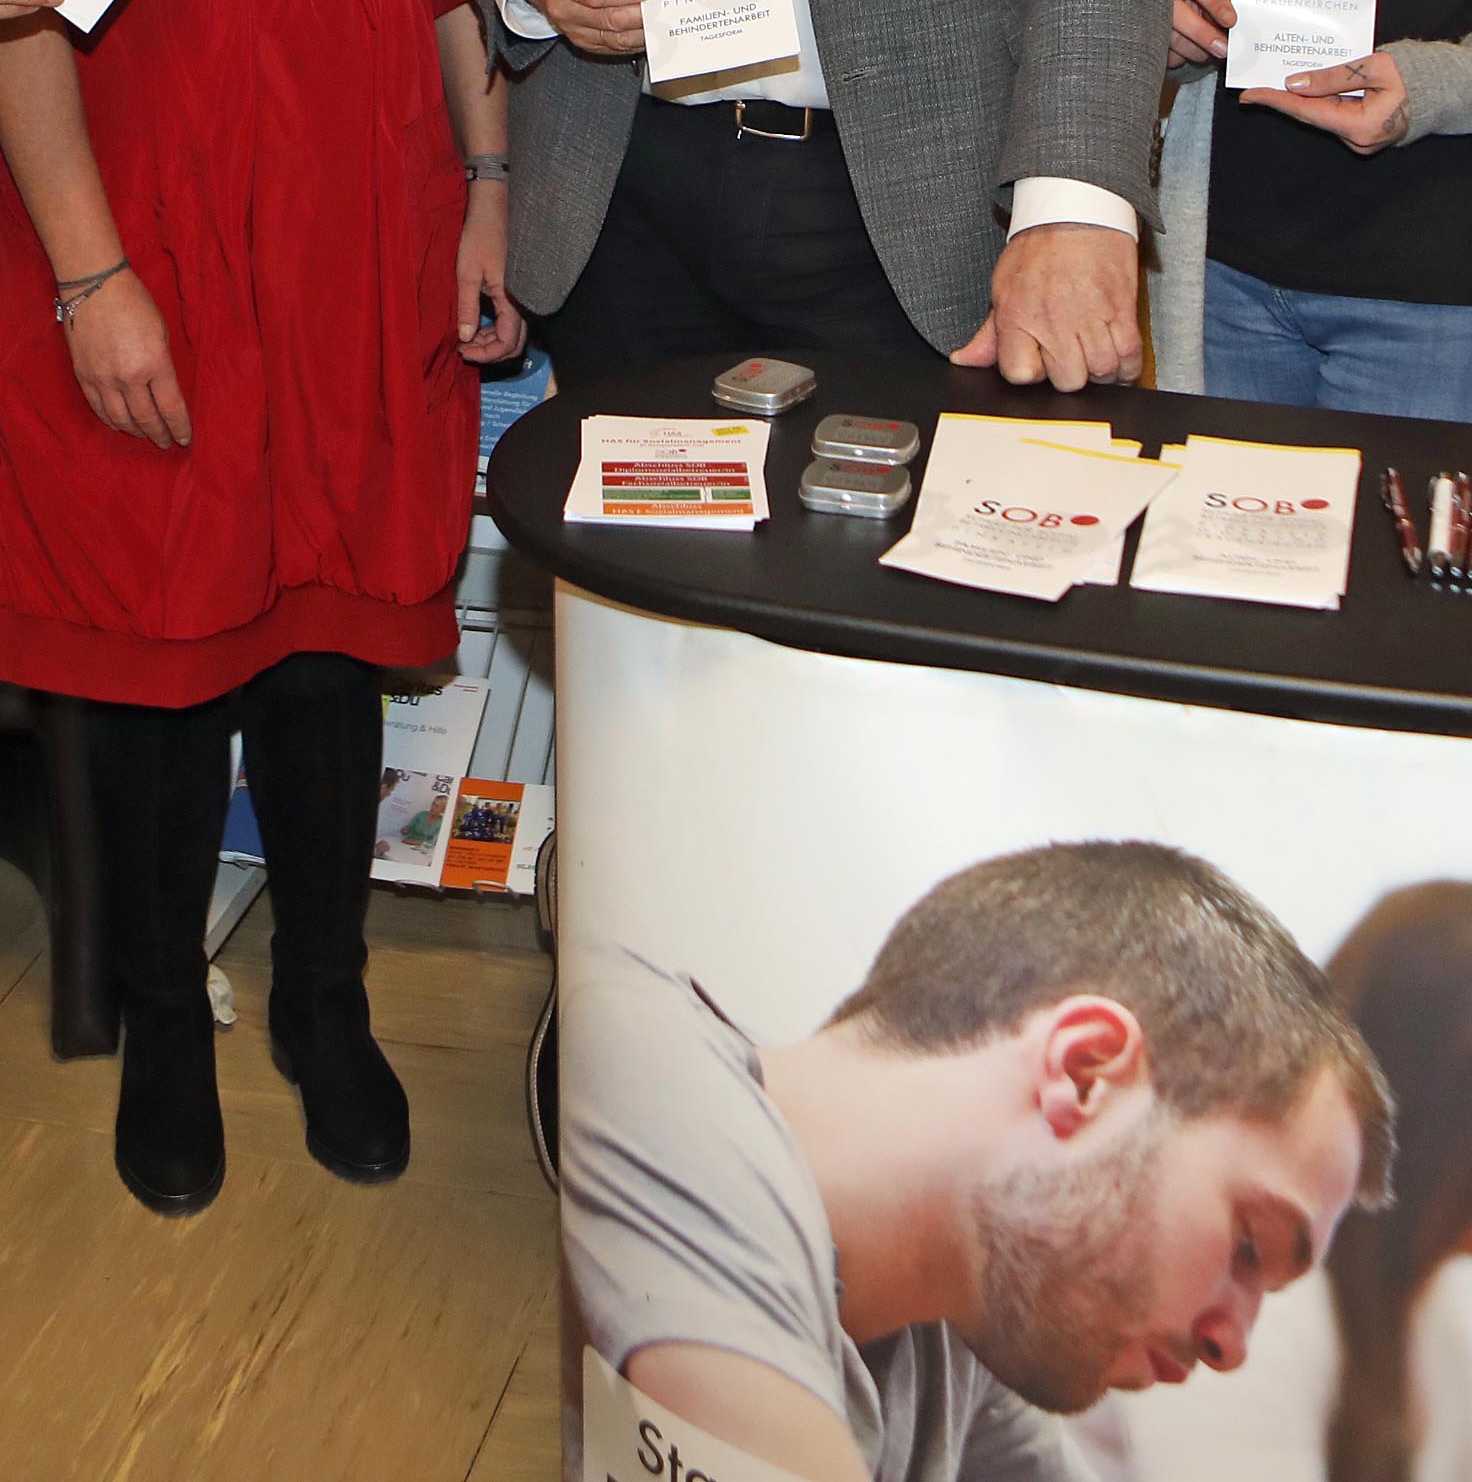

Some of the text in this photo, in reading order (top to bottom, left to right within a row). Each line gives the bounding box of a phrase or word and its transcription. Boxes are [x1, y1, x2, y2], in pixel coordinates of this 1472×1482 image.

[669, 9, 771, 37] BEHINDERTENARBEIT
[680, 3, 757, 25] FAMILIEN- UND
[700, 29, 743, 42] TAGESFORM
[1273, 33, 1335, 45] ALTEN- UND
[1254, 43, 1352, 57] BEHINDERTENARBEIT
[974, 500, 1063, 528] SOB
[1204, 492, 1296, 515] SOB
